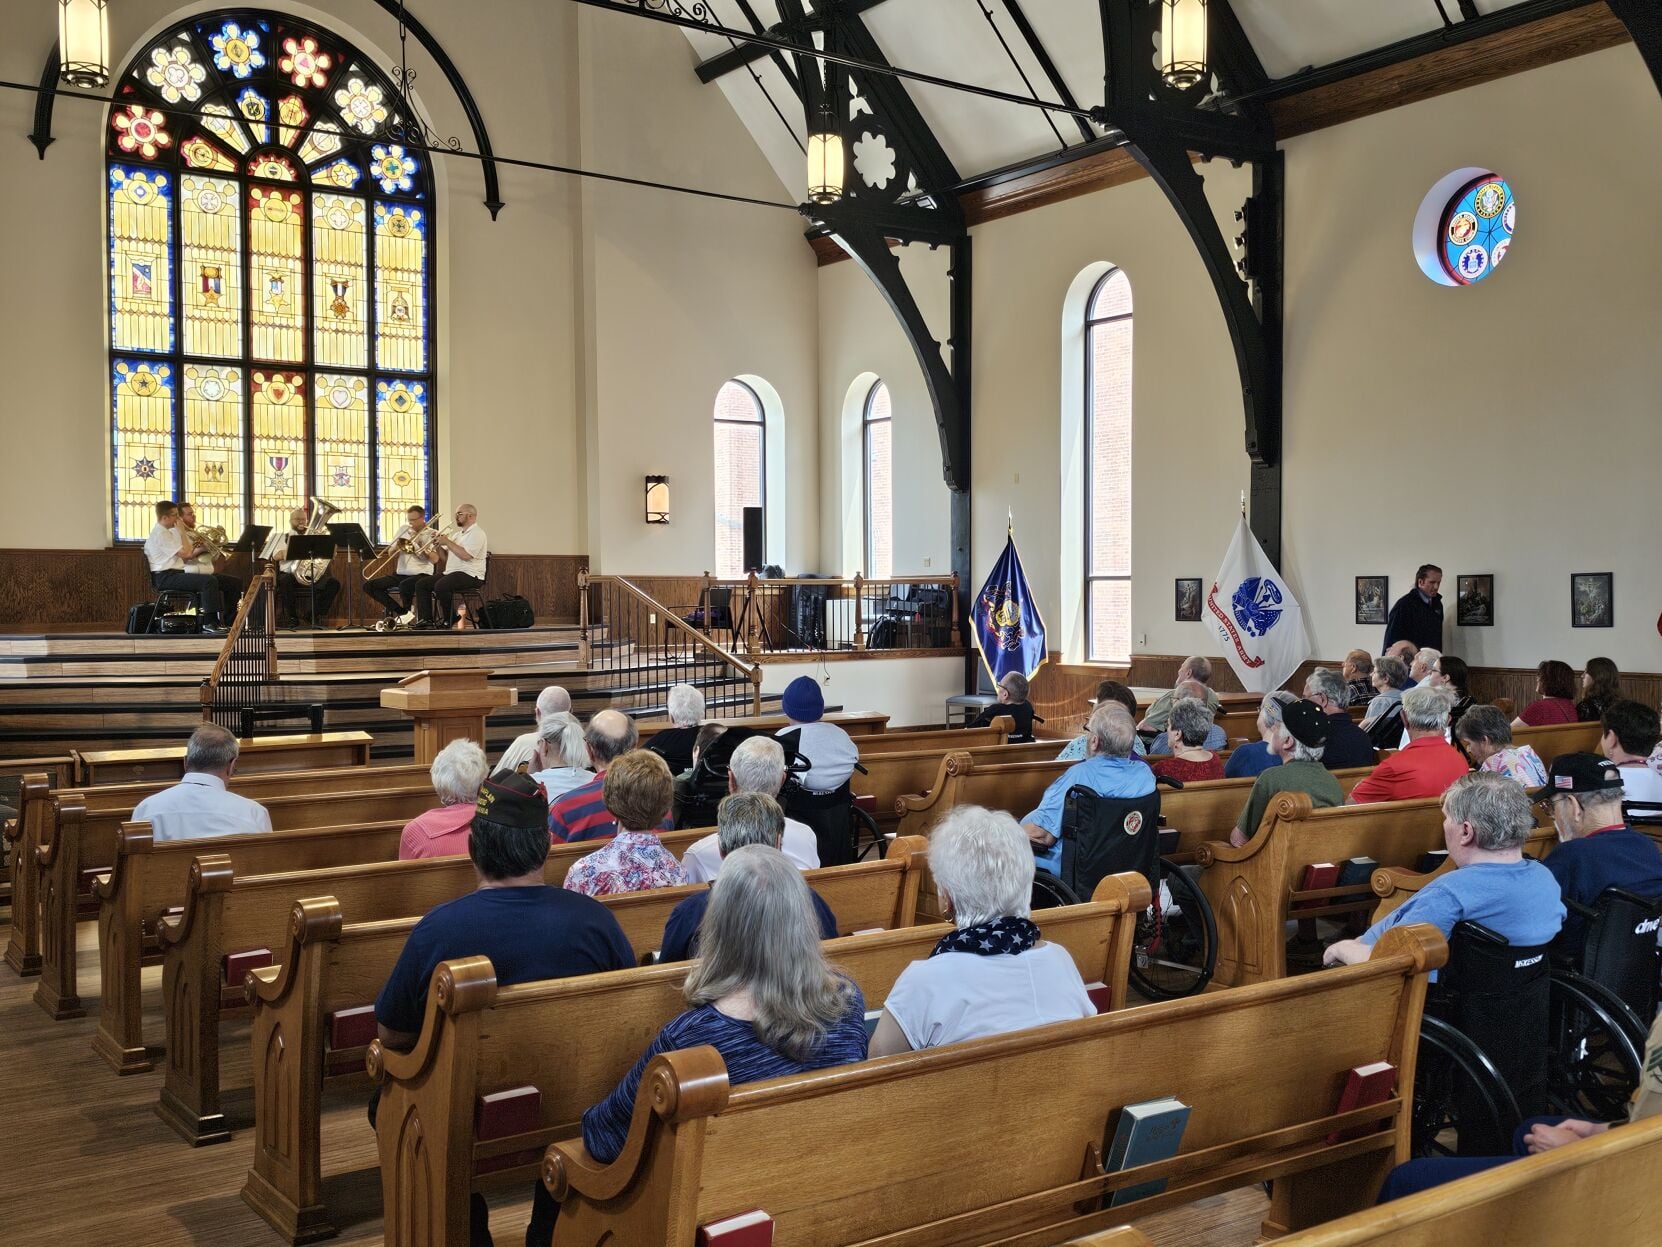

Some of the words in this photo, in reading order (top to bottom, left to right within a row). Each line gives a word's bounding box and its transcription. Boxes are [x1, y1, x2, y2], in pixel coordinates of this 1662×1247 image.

[1208, 596, 1223, 619] UNITED
[1223, 617, 1239, 643] STATES
[1237, 643, 1252, 664] ARMY
[1218, 625, 1230, 642] 1775
